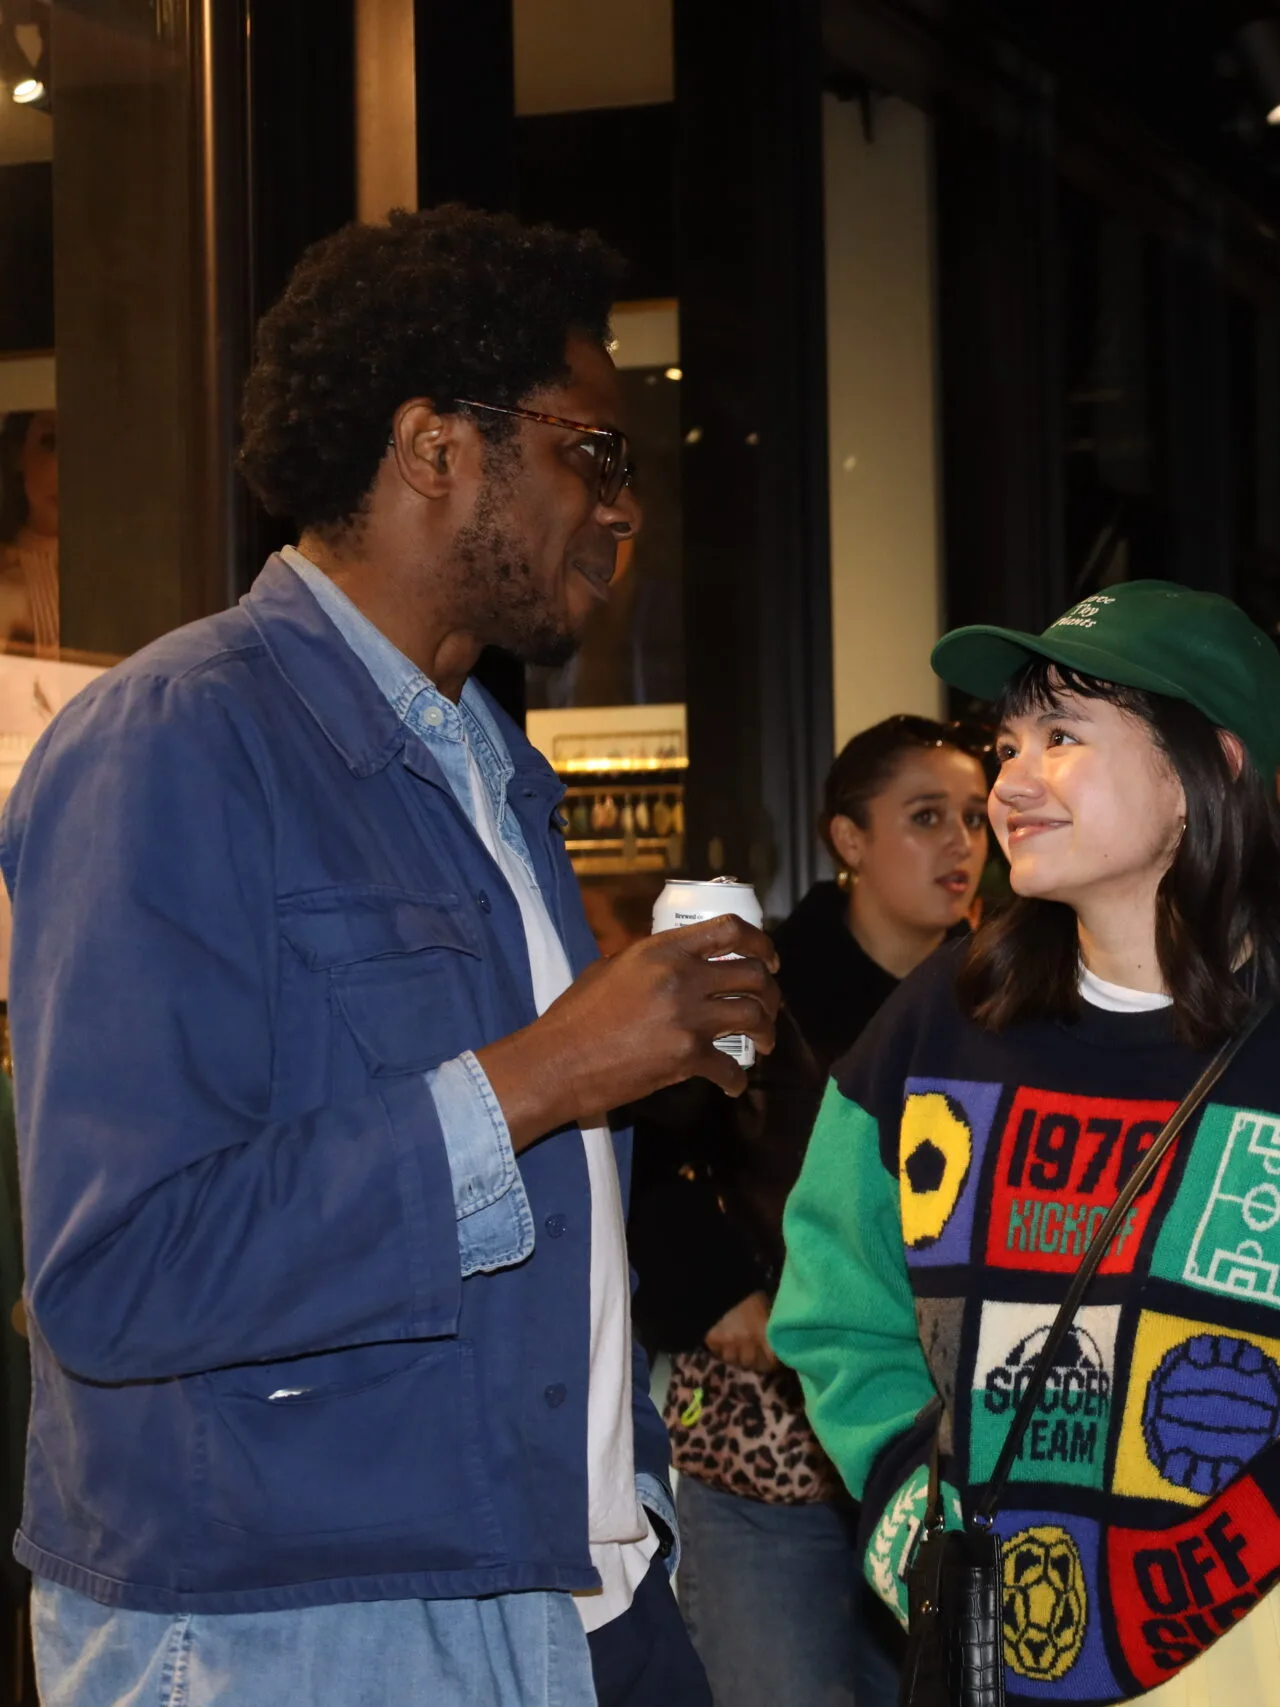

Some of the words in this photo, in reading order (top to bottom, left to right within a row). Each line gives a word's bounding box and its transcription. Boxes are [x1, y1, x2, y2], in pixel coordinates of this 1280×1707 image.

[1007, 1109, 1167, 1196] 1976
[1006, 1199, 1138, 1257] KICKOF
[1012, 1419, 1098, 1465] EAM
[1133, 1511, 1250, 1615] OFF
